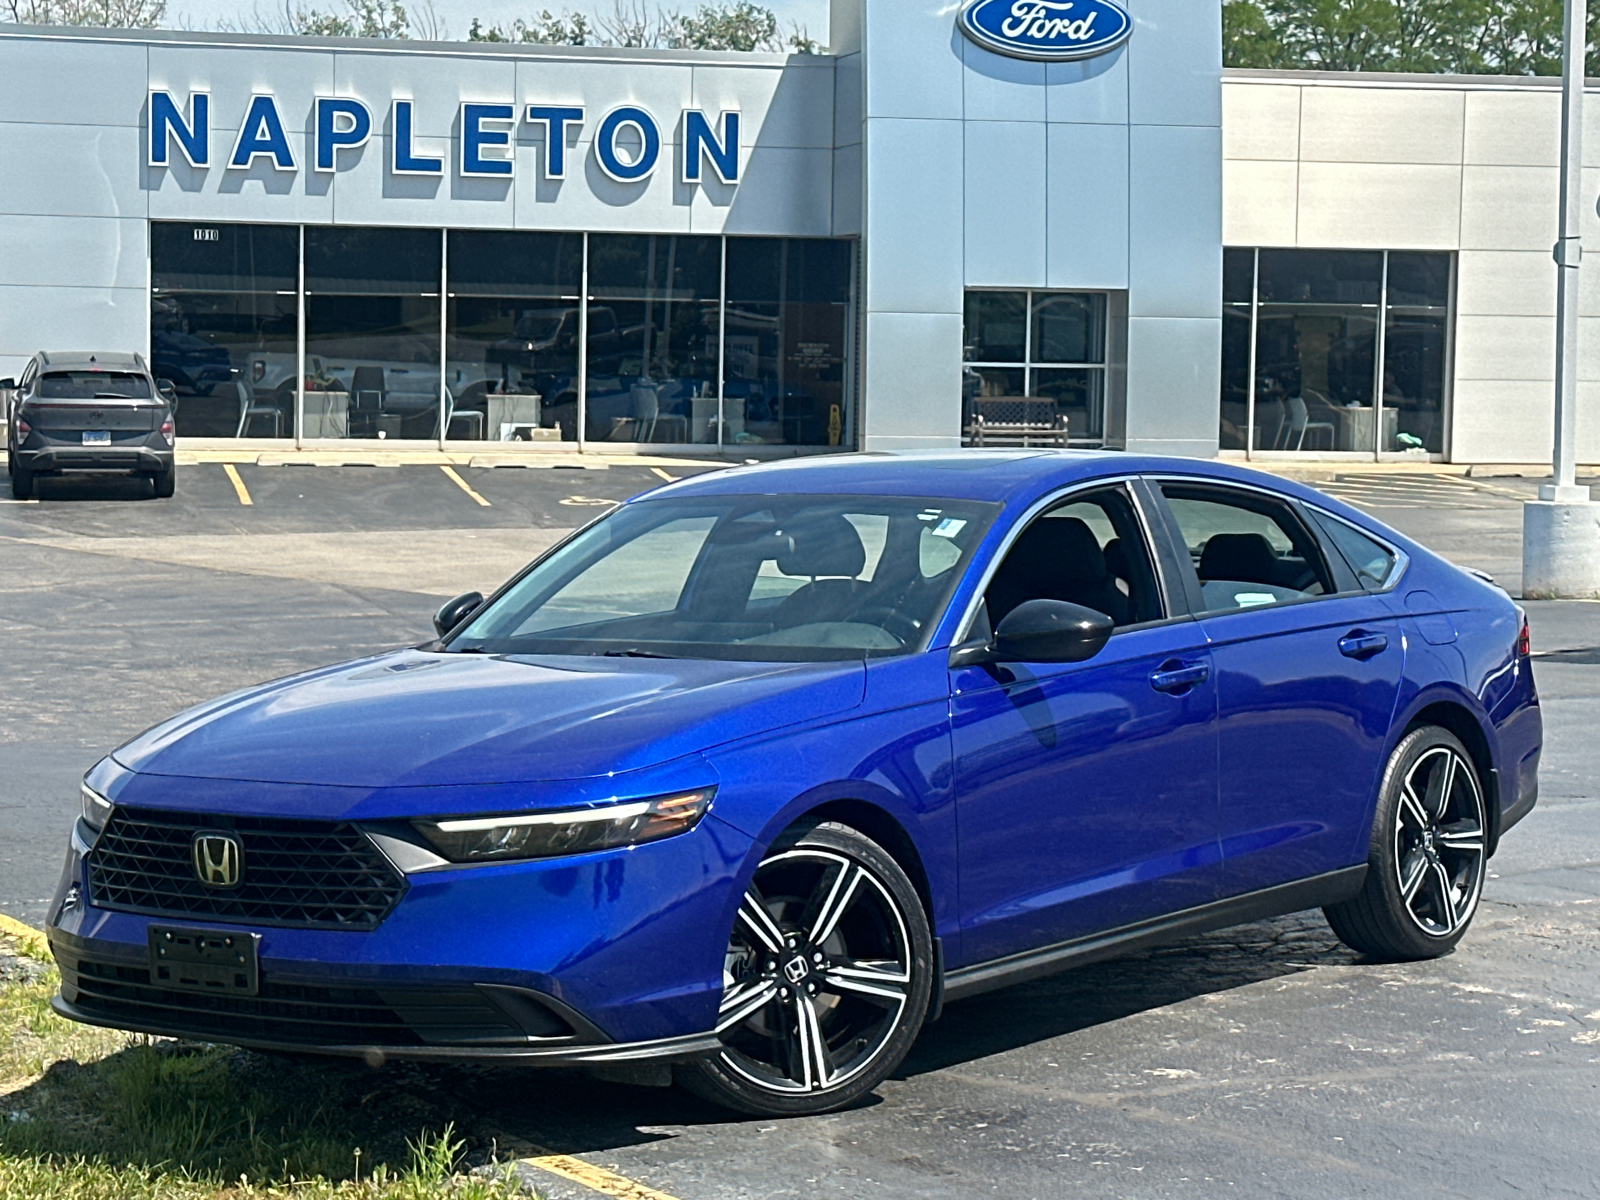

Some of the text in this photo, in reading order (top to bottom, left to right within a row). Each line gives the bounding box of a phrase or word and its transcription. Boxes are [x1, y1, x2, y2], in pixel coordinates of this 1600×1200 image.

[1002, 0, 1098, 40] Ford
[148, 90, 742, 184] NAPLETON
[194, 229, 218, 241] 1010
